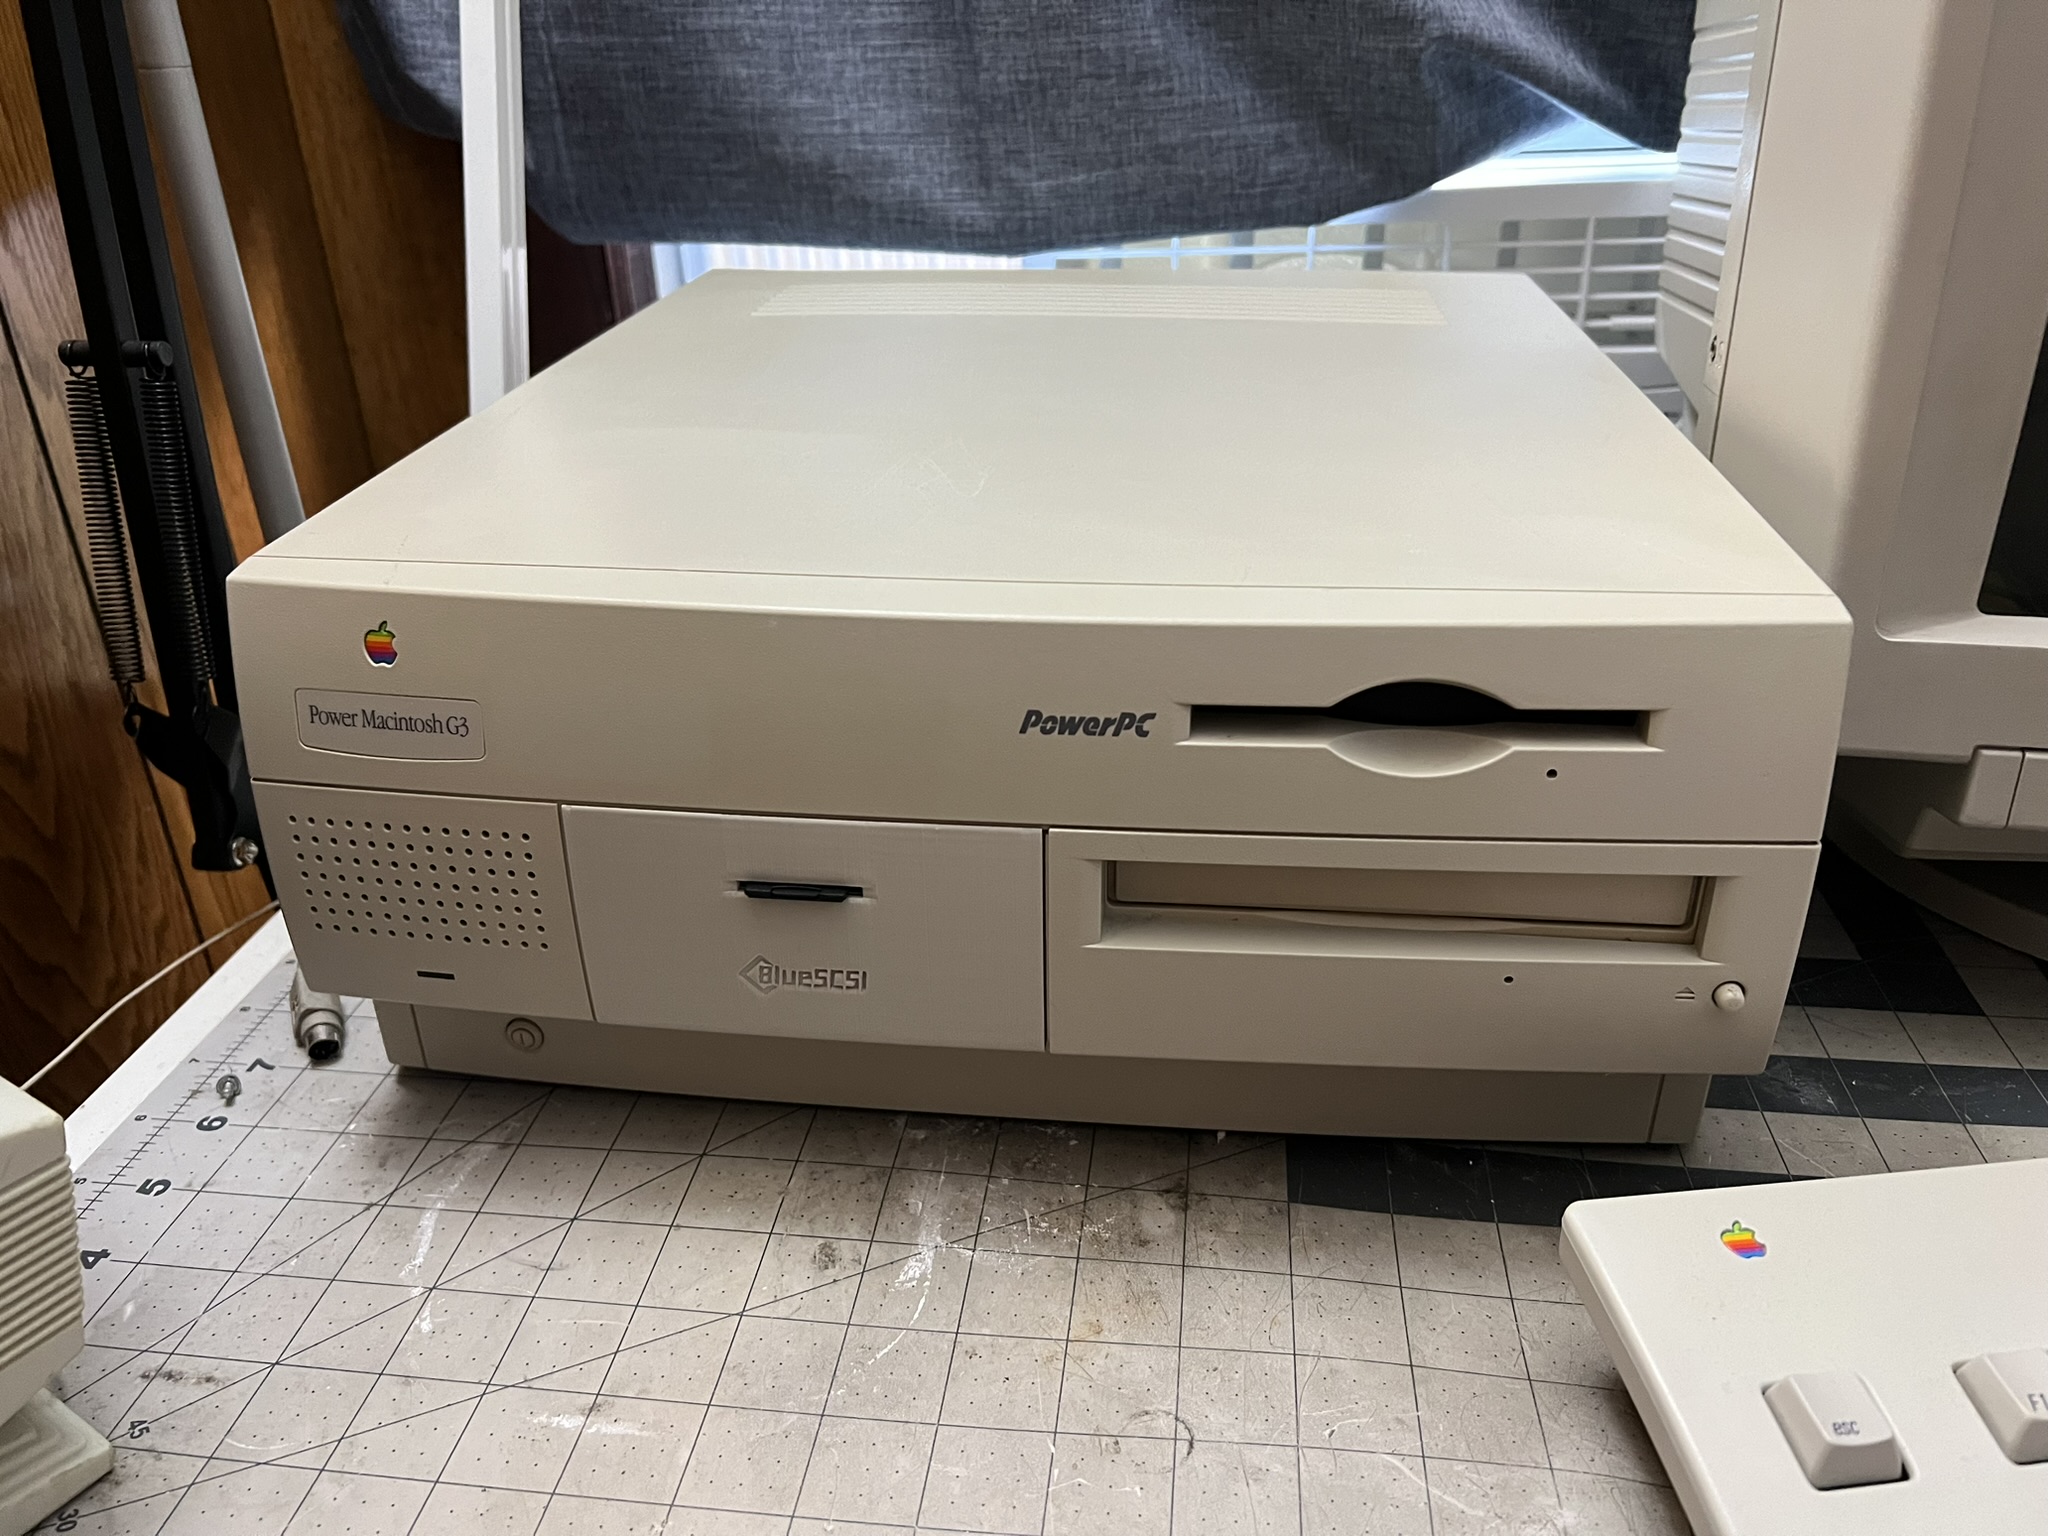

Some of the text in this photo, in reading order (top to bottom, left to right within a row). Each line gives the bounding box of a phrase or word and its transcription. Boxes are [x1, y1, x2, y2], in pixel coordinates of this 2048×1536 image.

[308, 704, 470, 738] Power Macintosh G3
[1018, 708, 1157, 738] PowerPC
[757, 964, 868, 992] BlueSCSI
[245, 1057, 276, 1073] 7
[134, 1114, 148, 1122] 6
[196, 1115, 229, 1132] 6
[135, 1178, 172, 1197] 5
[80, 1248, 112, 1270] 4
[128, 1420, 150, 1440] 45
[1832, 1421, 1861, 1437] esc
[55, 1508, 79, 1533] 30
